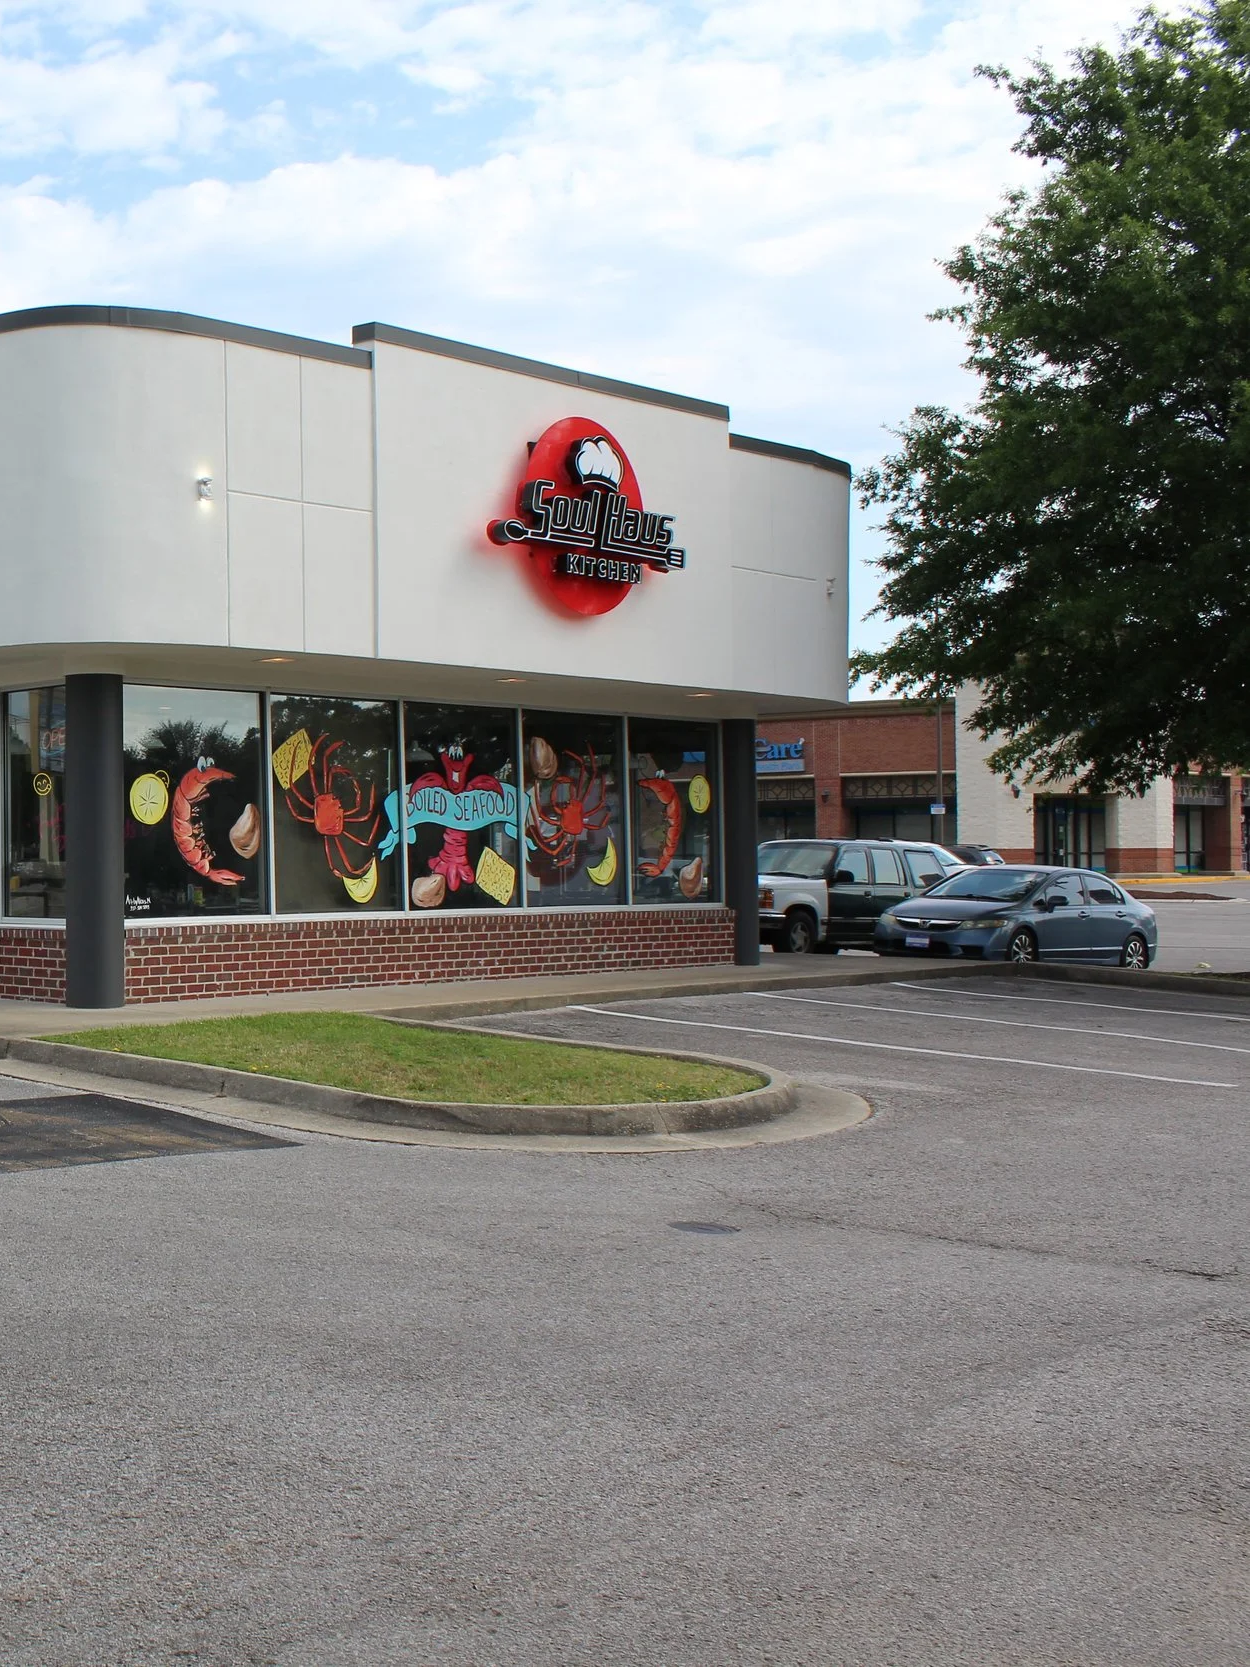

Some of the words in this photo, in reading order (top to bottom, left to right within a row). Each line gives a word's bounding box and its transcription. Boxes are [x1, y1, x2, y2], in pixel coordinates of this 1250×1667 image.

[532, 479, 601, 541] Soul
[602, 491, 676, 550] Haus
[566, 553, 643, 585] KITCHEN
[42, 727, 66, 750] OPE
[405, 789, 448, 817] BOILED
[453, 791, 515, 821] SEAFOOD
